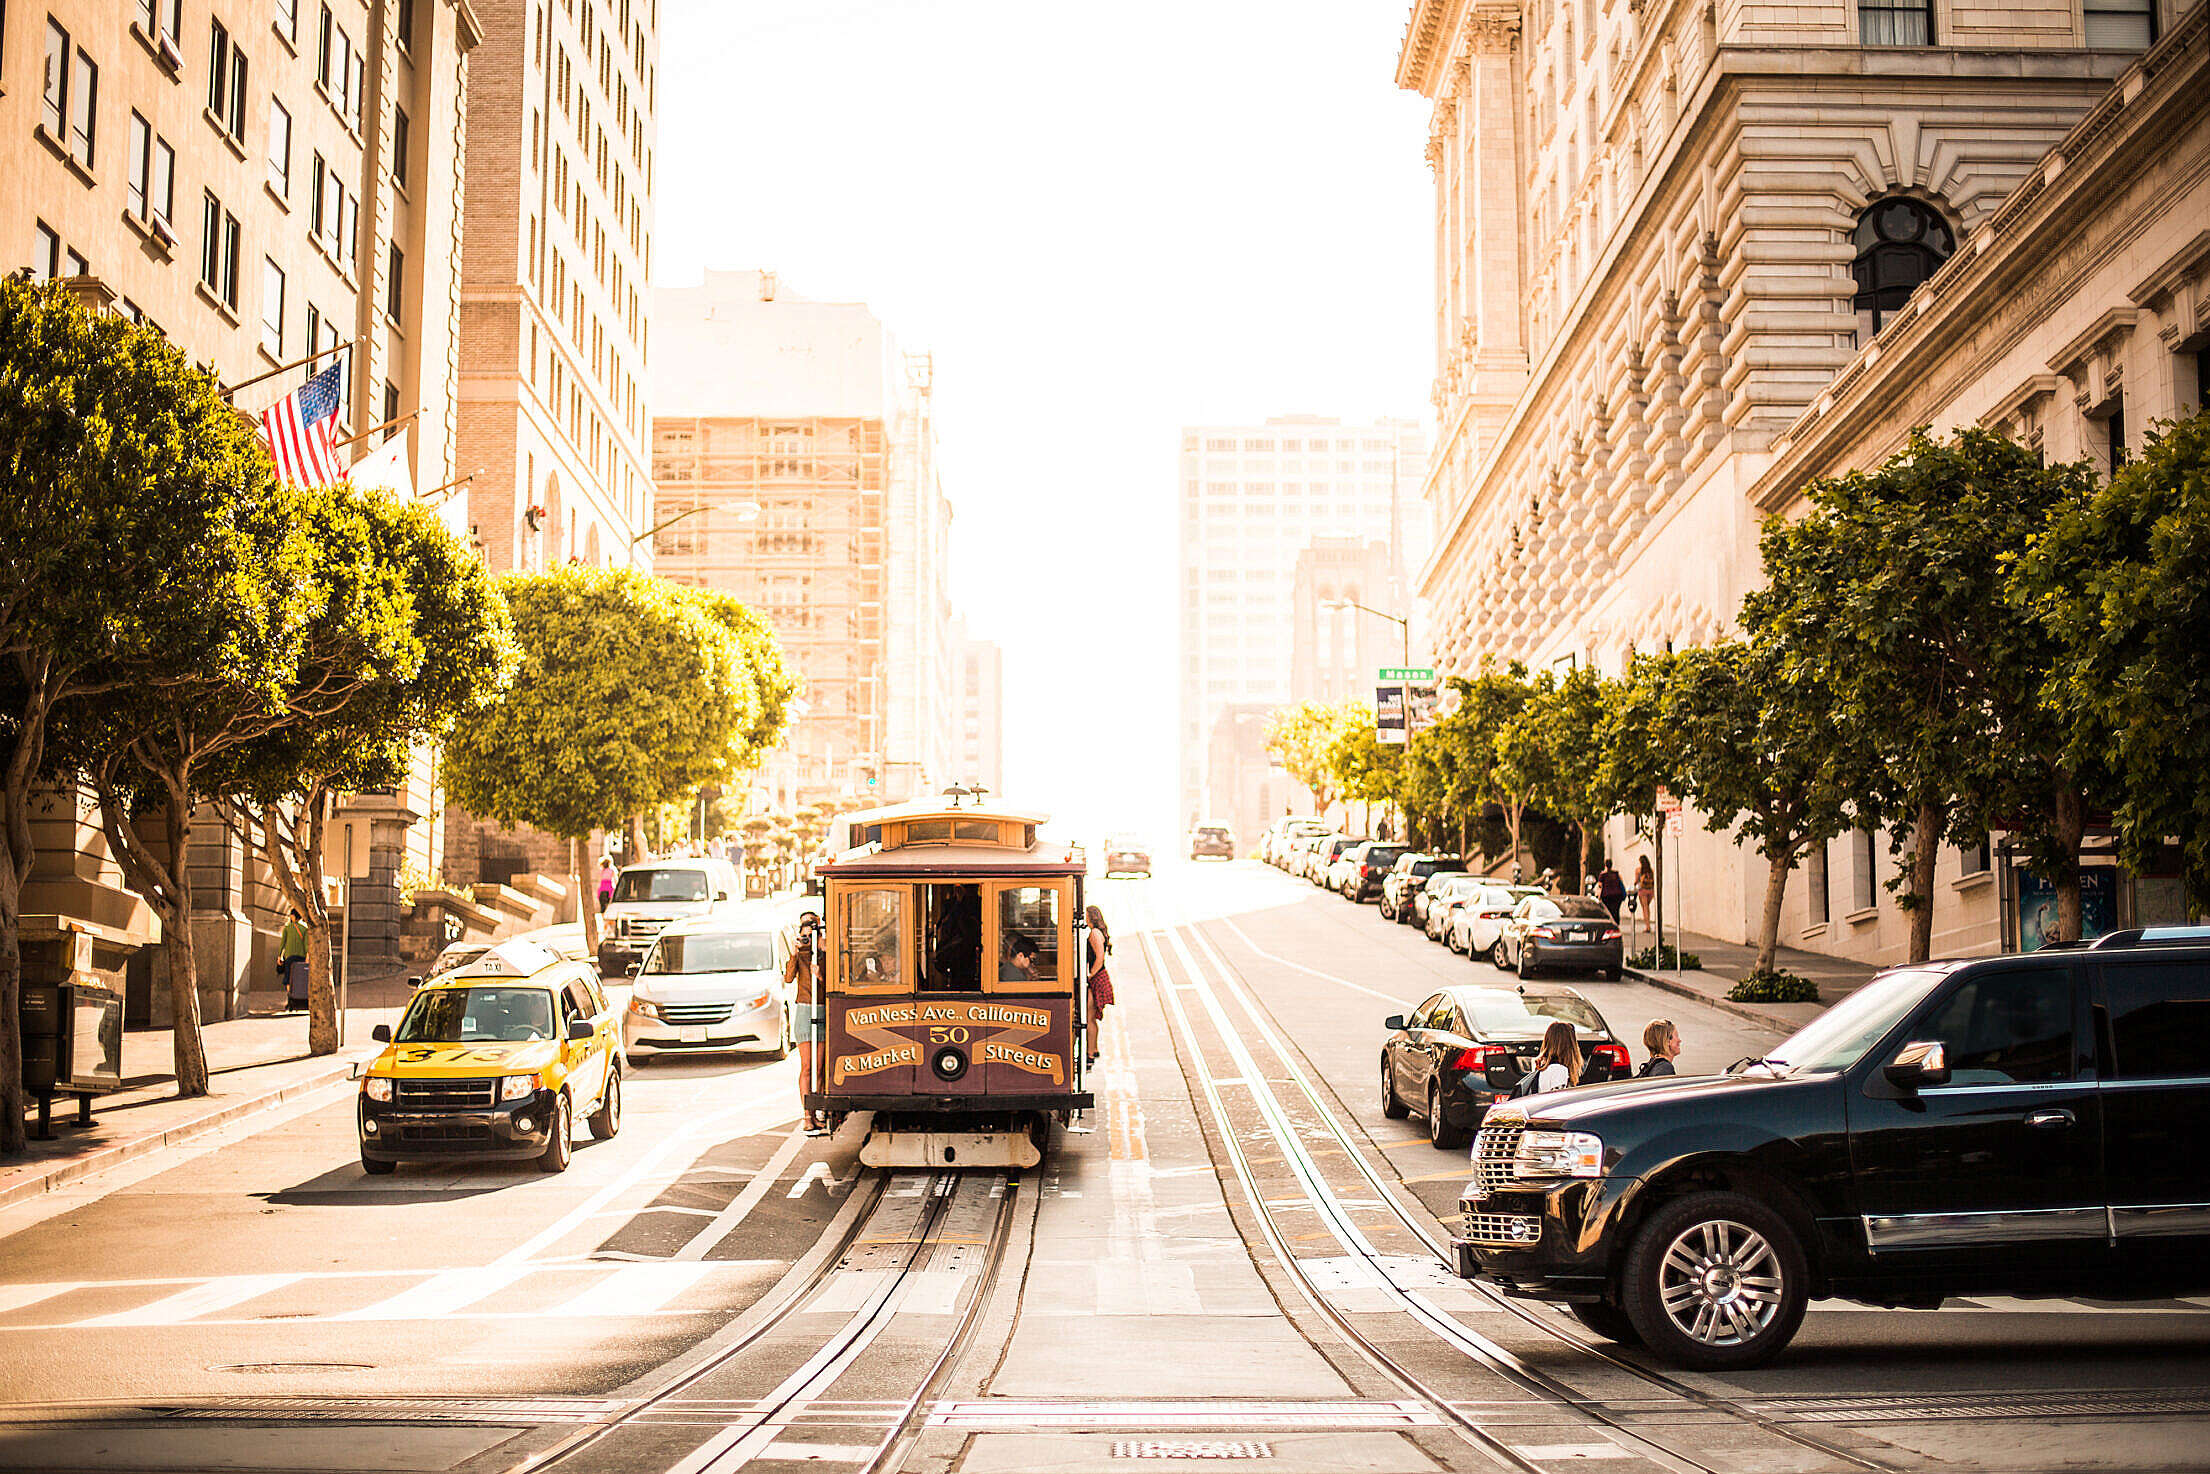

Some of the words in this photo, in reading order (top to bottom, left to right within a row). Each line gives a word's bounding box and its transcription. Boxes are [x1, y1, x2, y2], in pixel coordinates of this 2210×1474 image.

[484, 962, 502, 972] TAXI
[849, 1011, 878, 1026] Van
[879, 1006, 918, 1022] Ness
[967, 1005, 1049, 1027] California
[929, 1026, 970, 1044] 50
[398, 1048, 511, 1063] 373
[843, 1056, 857, 1072] &
[858, 1046, 917, 1070] Market
[984, 1044, 1053, 1069] Streets
